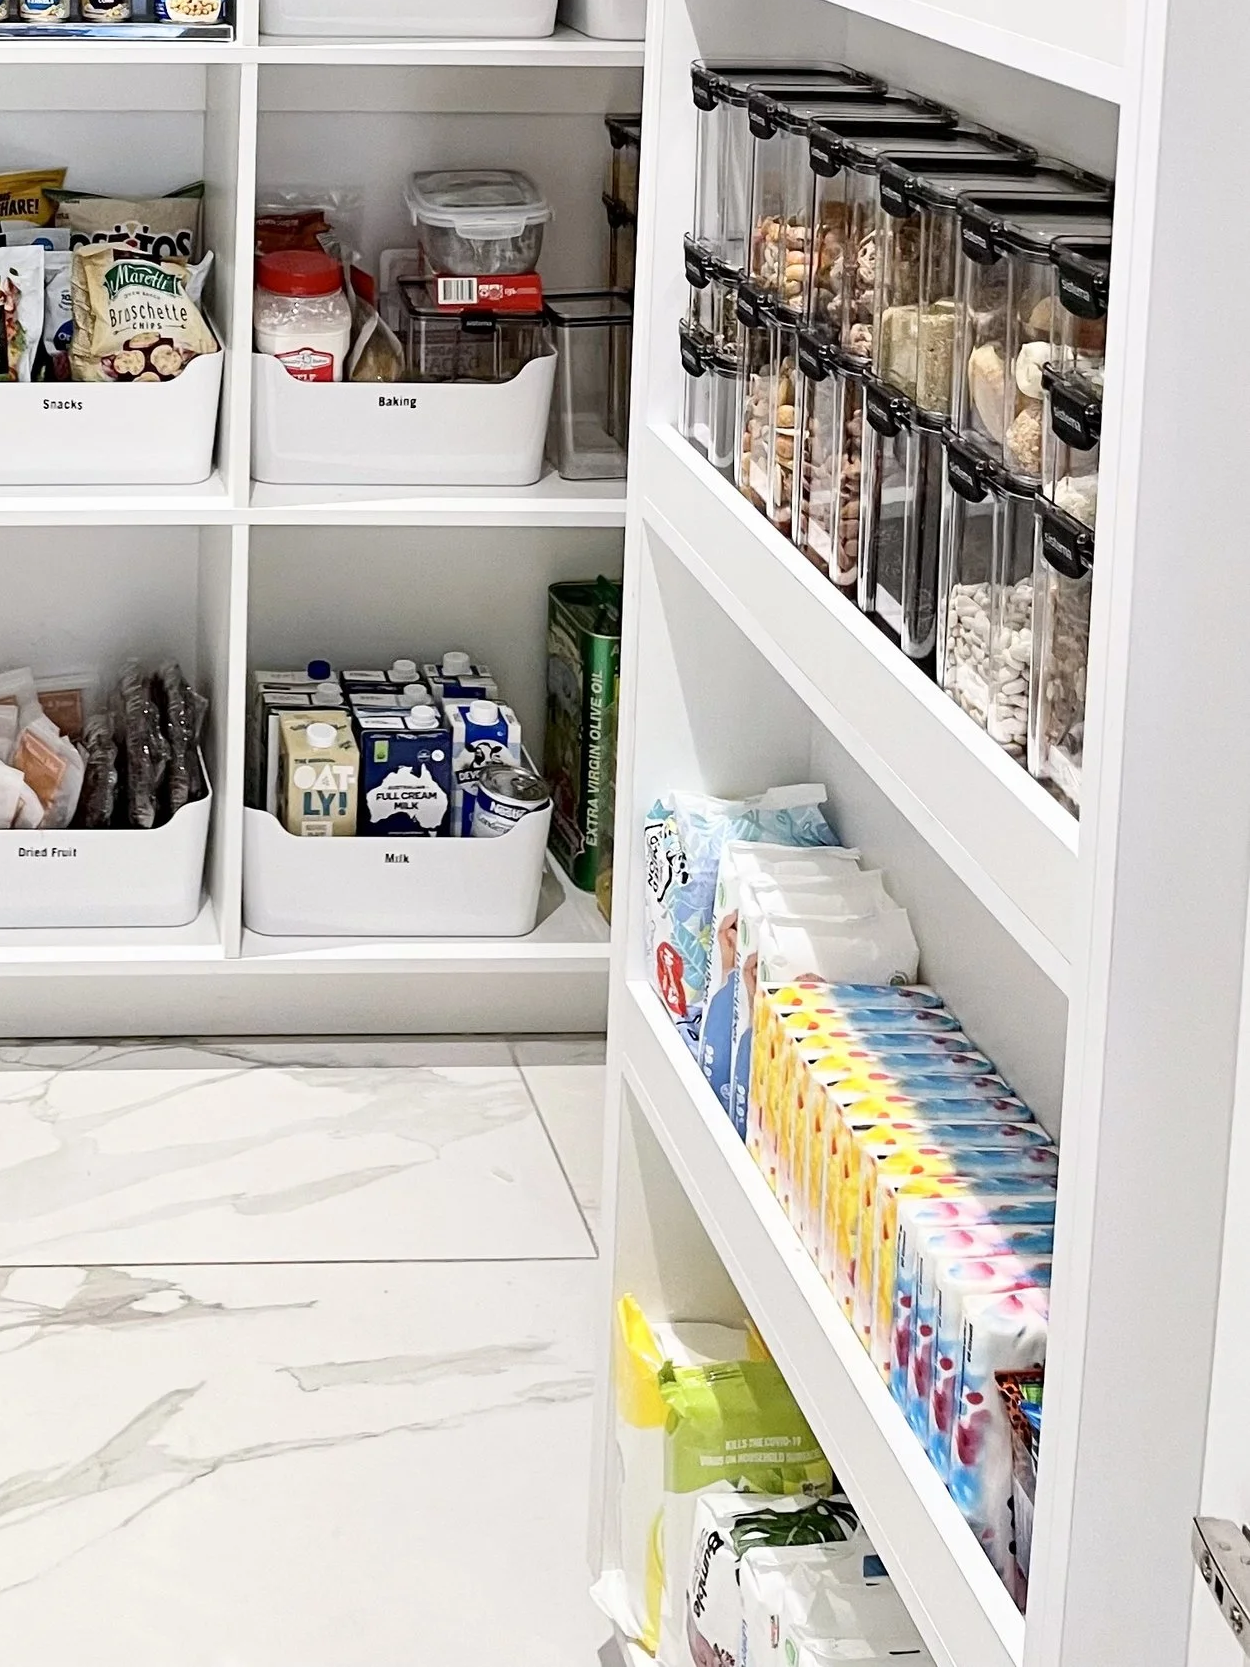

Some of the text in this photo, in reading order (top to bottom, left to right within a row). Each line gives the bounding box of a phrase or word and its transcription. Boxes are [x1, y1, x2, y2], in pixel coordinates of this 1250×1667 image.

[131, 322, 163, 331] CHIPS
[42, 397, 84, 411] Snacks
[378, 395, 418, 410] Baking
[586, 670, 604, 847] EXTRA VIRGIN OLIVE OIL
[375, 791, 438, 801] FULL CREAM
[303, 790, 348, 817] LY!
[393, 801, 419, 811] MILK
[18, 846, 78, 858] Dried Fruit
[384, 853, 410, 864] Milk
